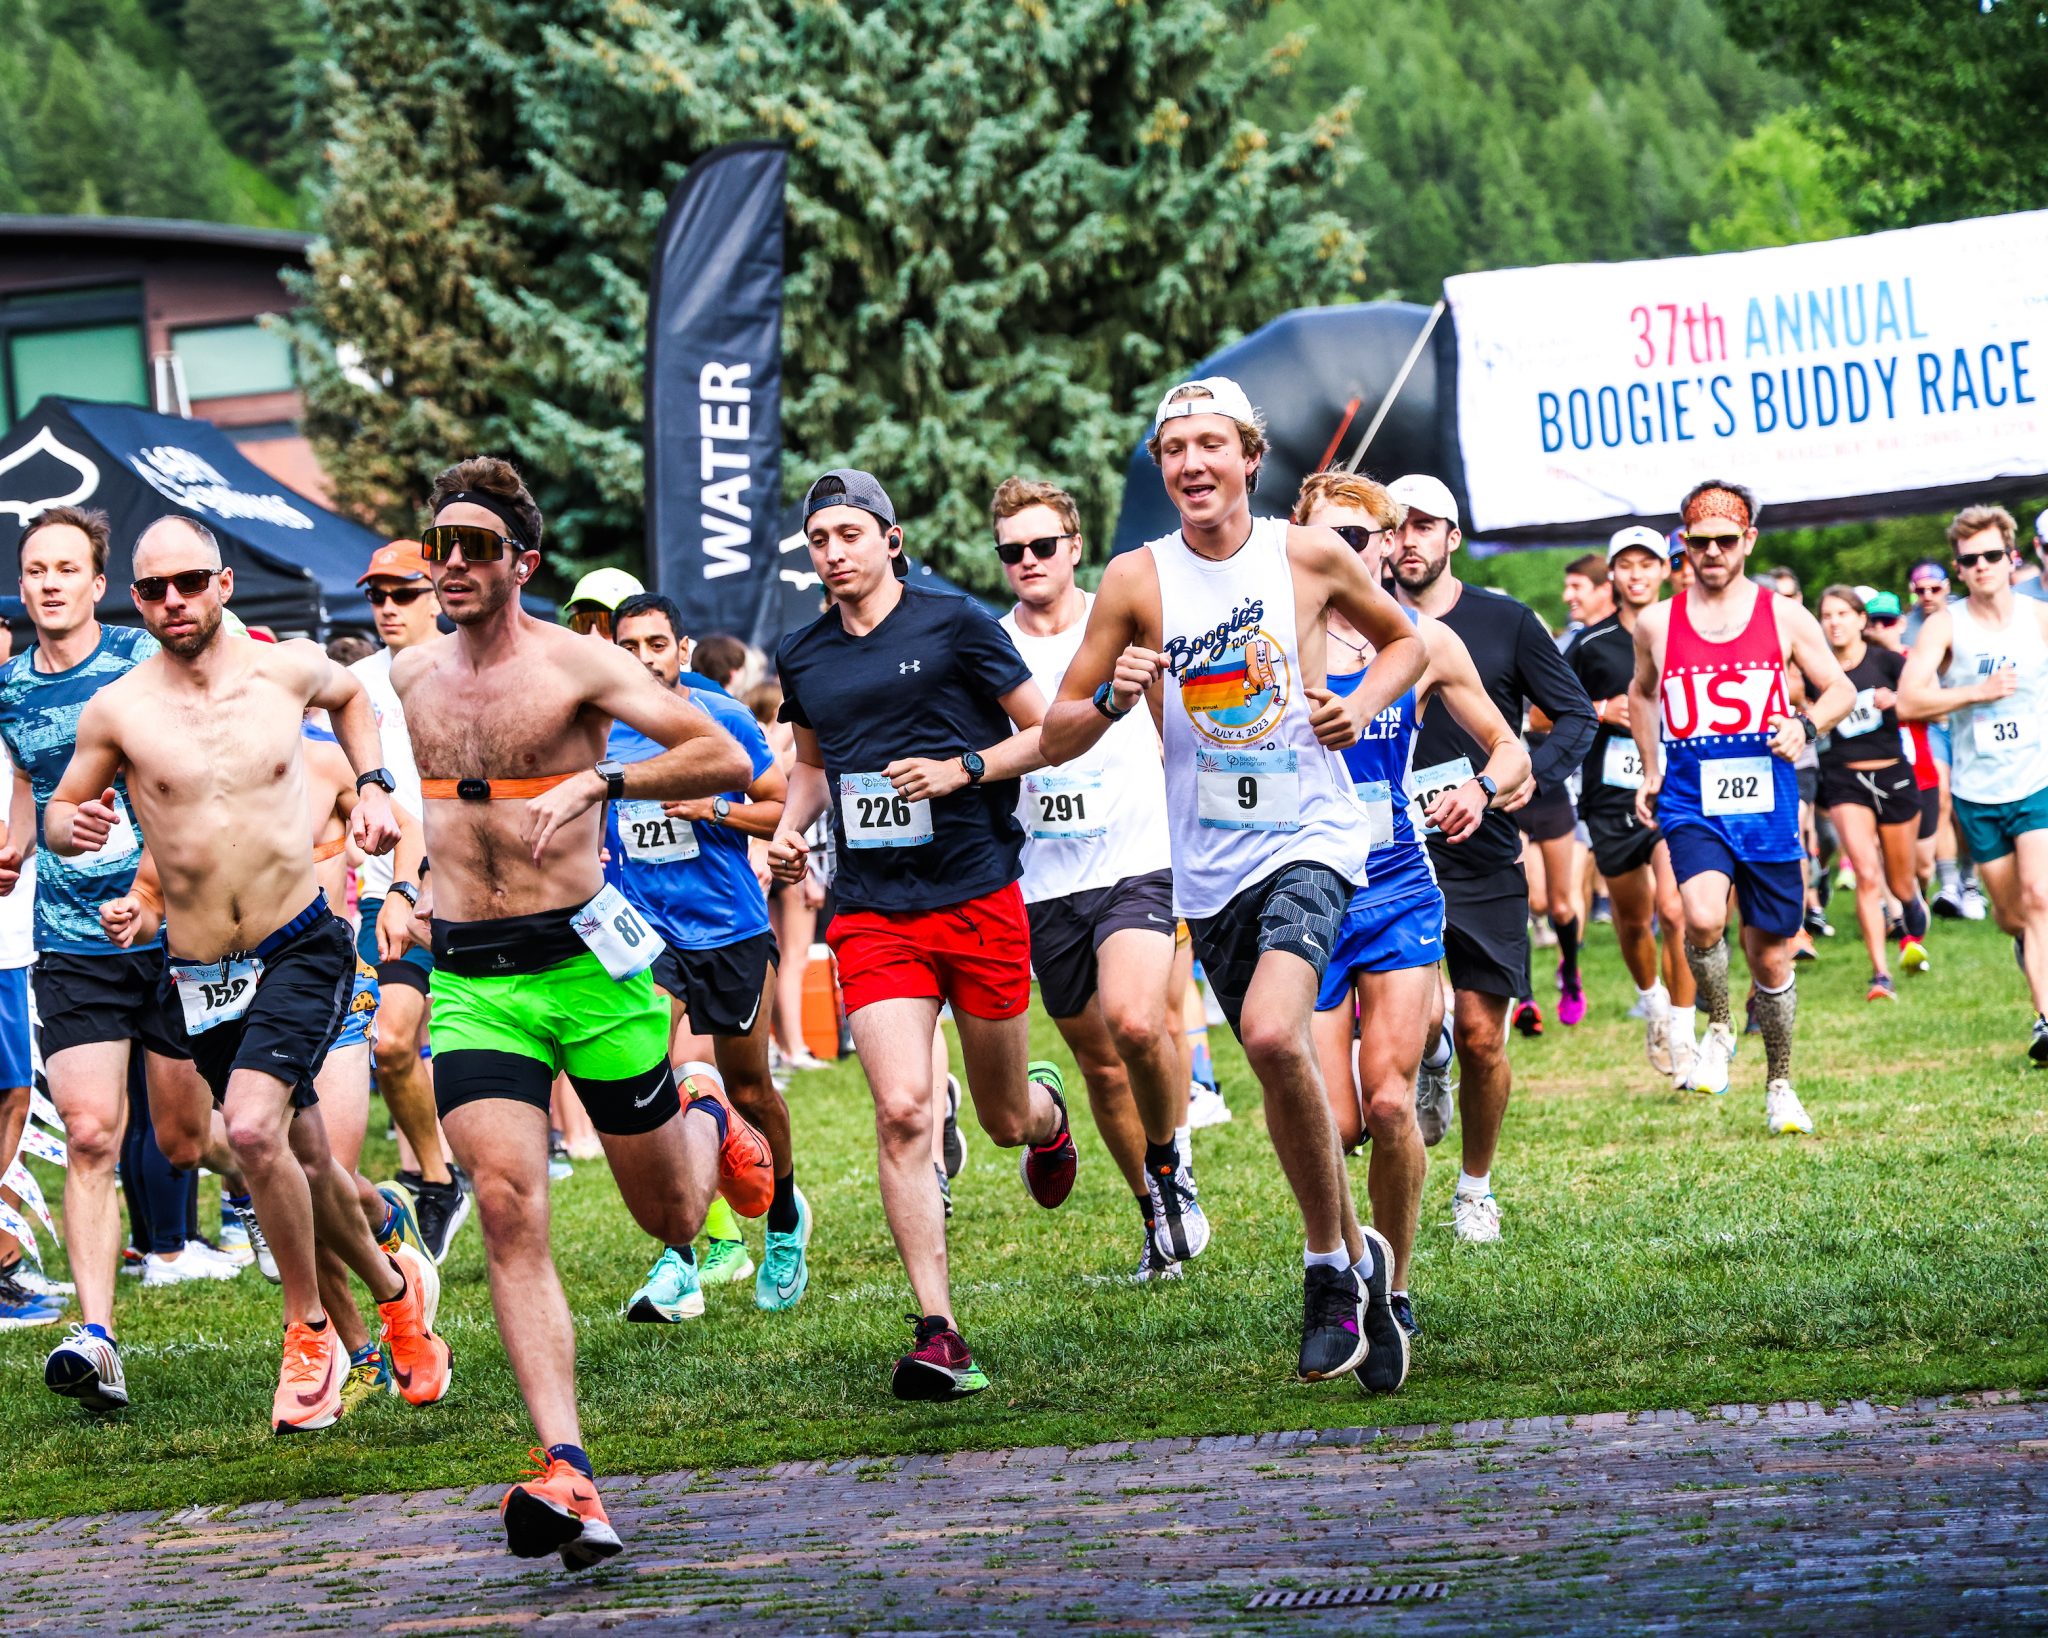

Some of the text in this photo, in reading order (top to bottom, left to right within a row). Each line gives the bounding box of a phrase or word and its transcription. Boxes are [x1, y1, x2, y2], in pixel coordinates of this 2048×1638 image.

[1630, 302, 1729, 369] 37th
[1744, 277, 1929, 358] ANNUAL
[1538, 374, 1736, 454] BOOGIE'S
[1751, 356, 1899, 435] BUDDY
[1917, 340, 2036, 416] RACE
[698, 360, 752, 580] WATER
[1163, 597, 1264, 678] Boogie's
[1661, 671, 1789, 740] USA
[1211, 719, 1269, 740] JULY 4, 2023
[1993, 722, 2019, 741] 33
[1237, 776, 1258, 809] 9
[1716, 776, 1759, 800] 282
[856, 795, 911, 829] 226
[1040, 793, 1085, 822] 291
[632, 818, 677, 849] 221
[613, 907, 646, 948] 87
[199, 978, 249, 1011] 159
